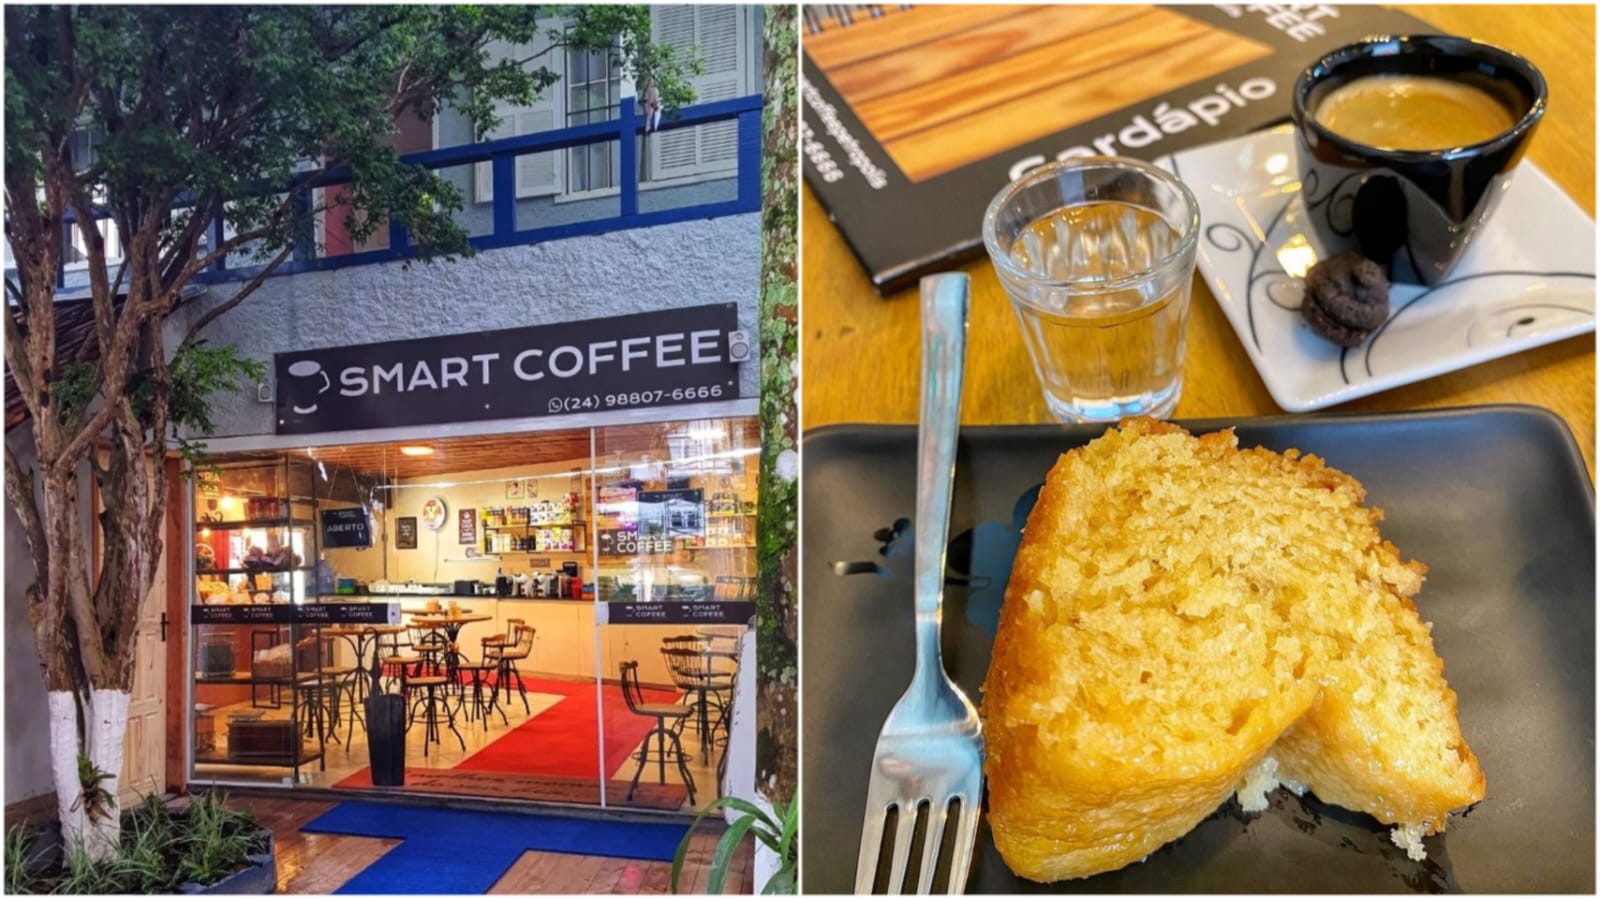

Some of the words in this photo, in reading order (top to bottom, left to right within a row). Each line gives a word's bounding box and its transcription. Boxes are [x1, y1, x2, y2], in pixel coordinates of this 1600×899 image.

[339, 353, 500, 396] SMART
[513, 329, 722, 382] COFFEE
[564, 394, 600, 411] (24)
[605, 384, 723, 407] 98807-6666
[327, 523, 365, 532] ABERTO
[617, 540, 673, 553] COFFEE
